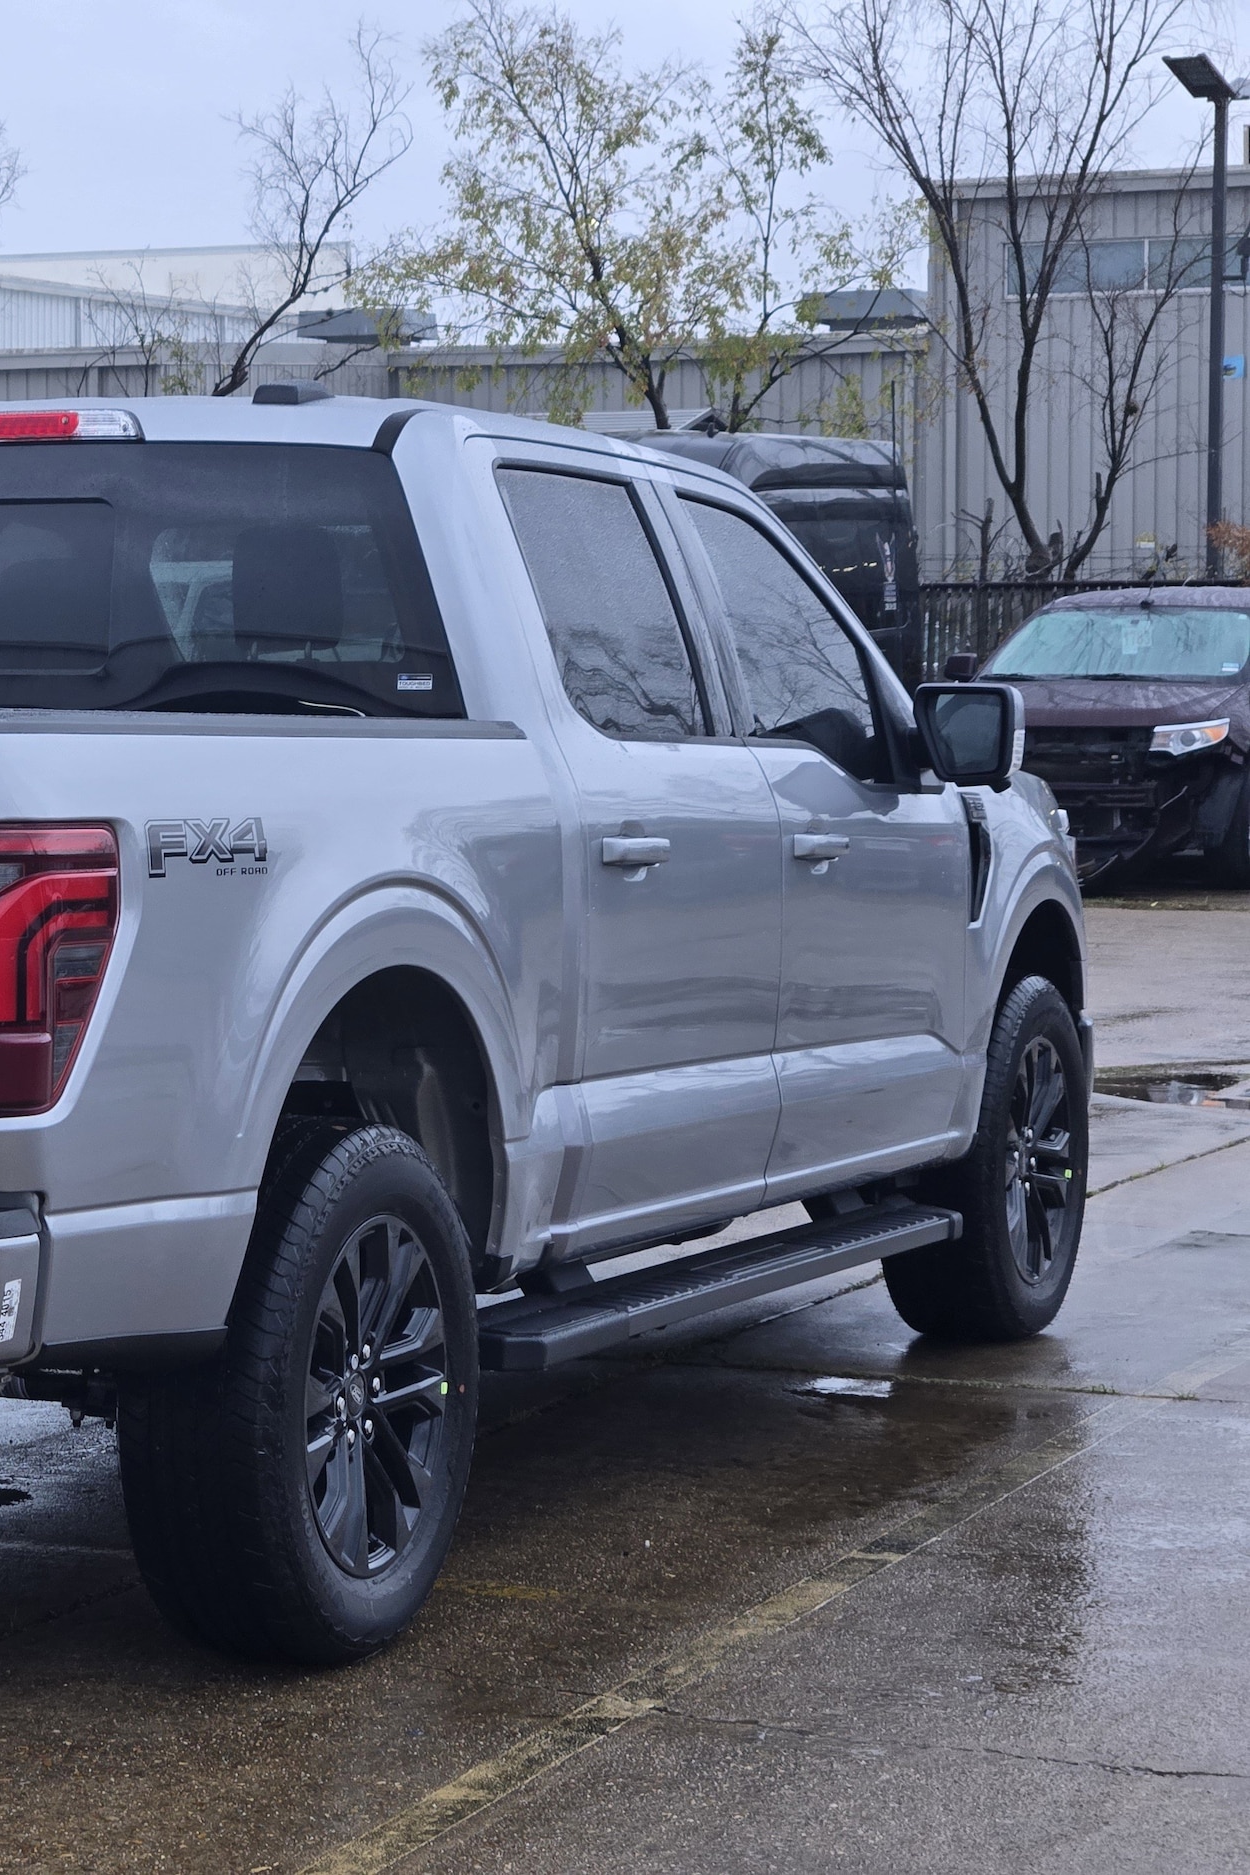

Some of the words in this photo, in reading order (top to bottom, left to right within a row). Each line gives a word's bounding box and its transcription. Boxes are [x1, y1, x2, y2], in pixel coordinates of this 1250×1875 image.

[144, 817, 268, 878] FX4
[216, 867, 237, 877] OFF
[241, 866, 268, 876] ROAD
